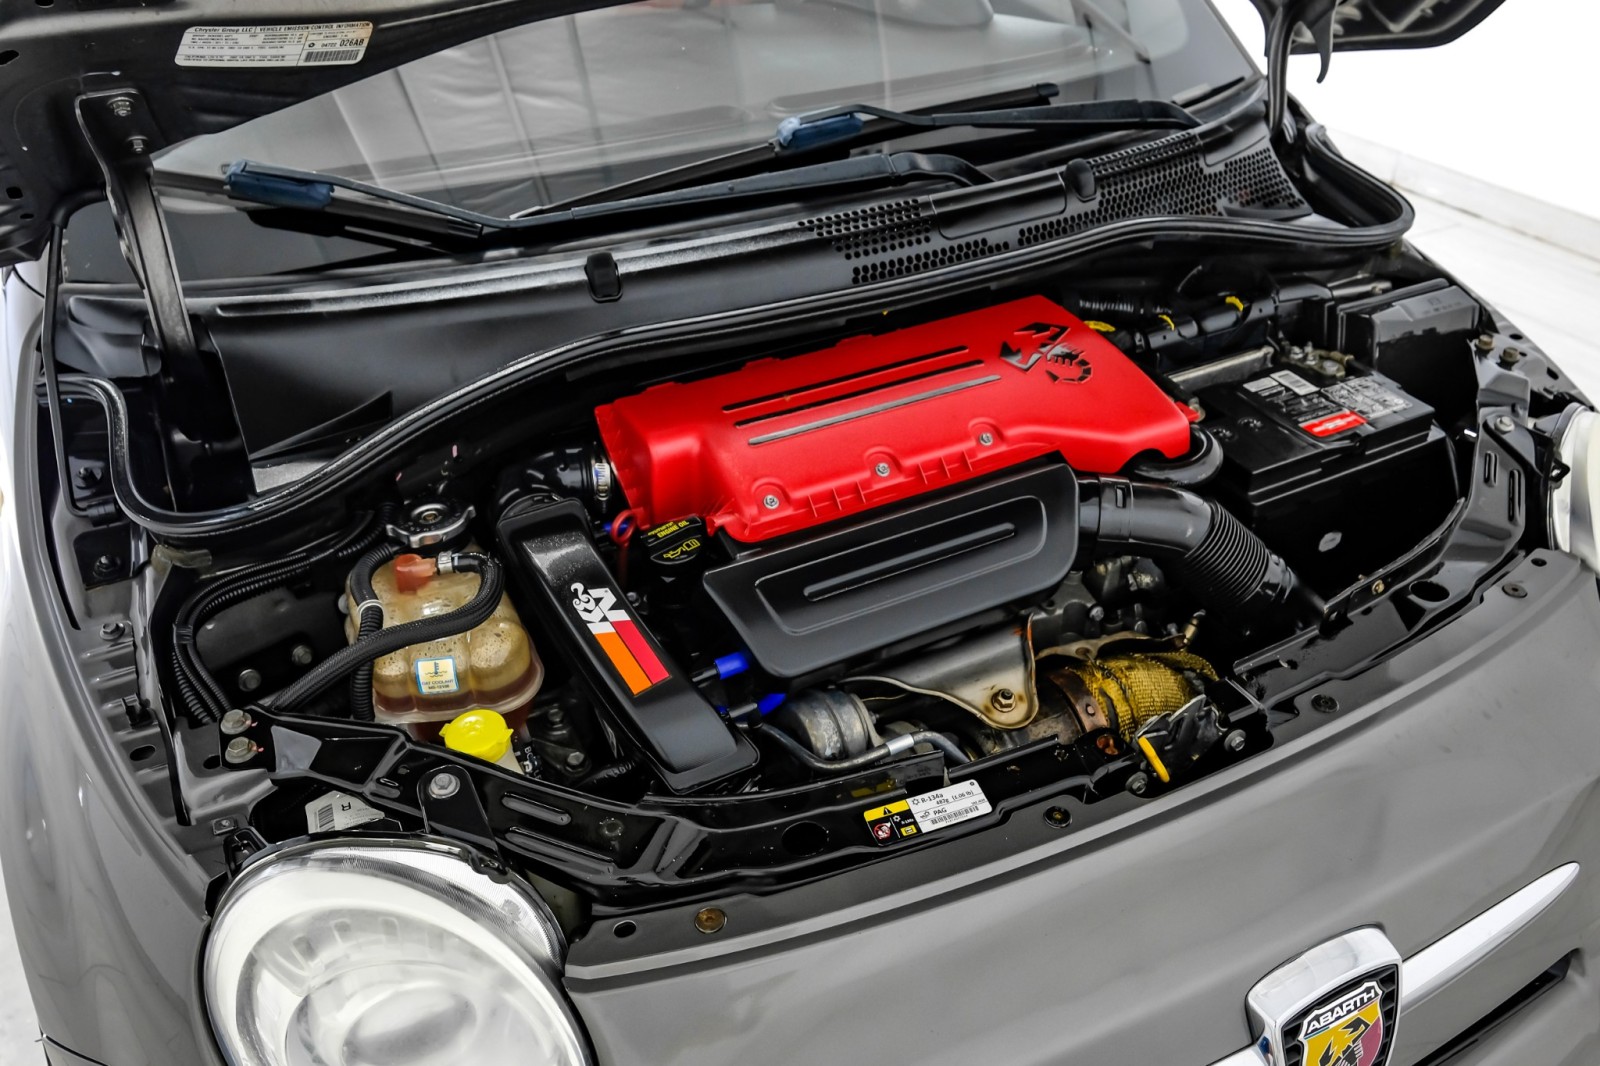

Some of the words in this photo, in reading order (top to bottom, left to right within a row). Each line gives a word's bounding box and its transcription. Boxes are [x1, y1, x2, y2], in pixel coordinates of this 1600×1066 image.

[339, 38, 365, 47] 026AB
[656, 524, 680, 538] ENGINE
[677, 520, 690, 528] OIL
[921, 793, 944, 803] R-134a
[933, 807, 948, 816] PAG
[1307, 989, 1375, 1033] ABARTH
